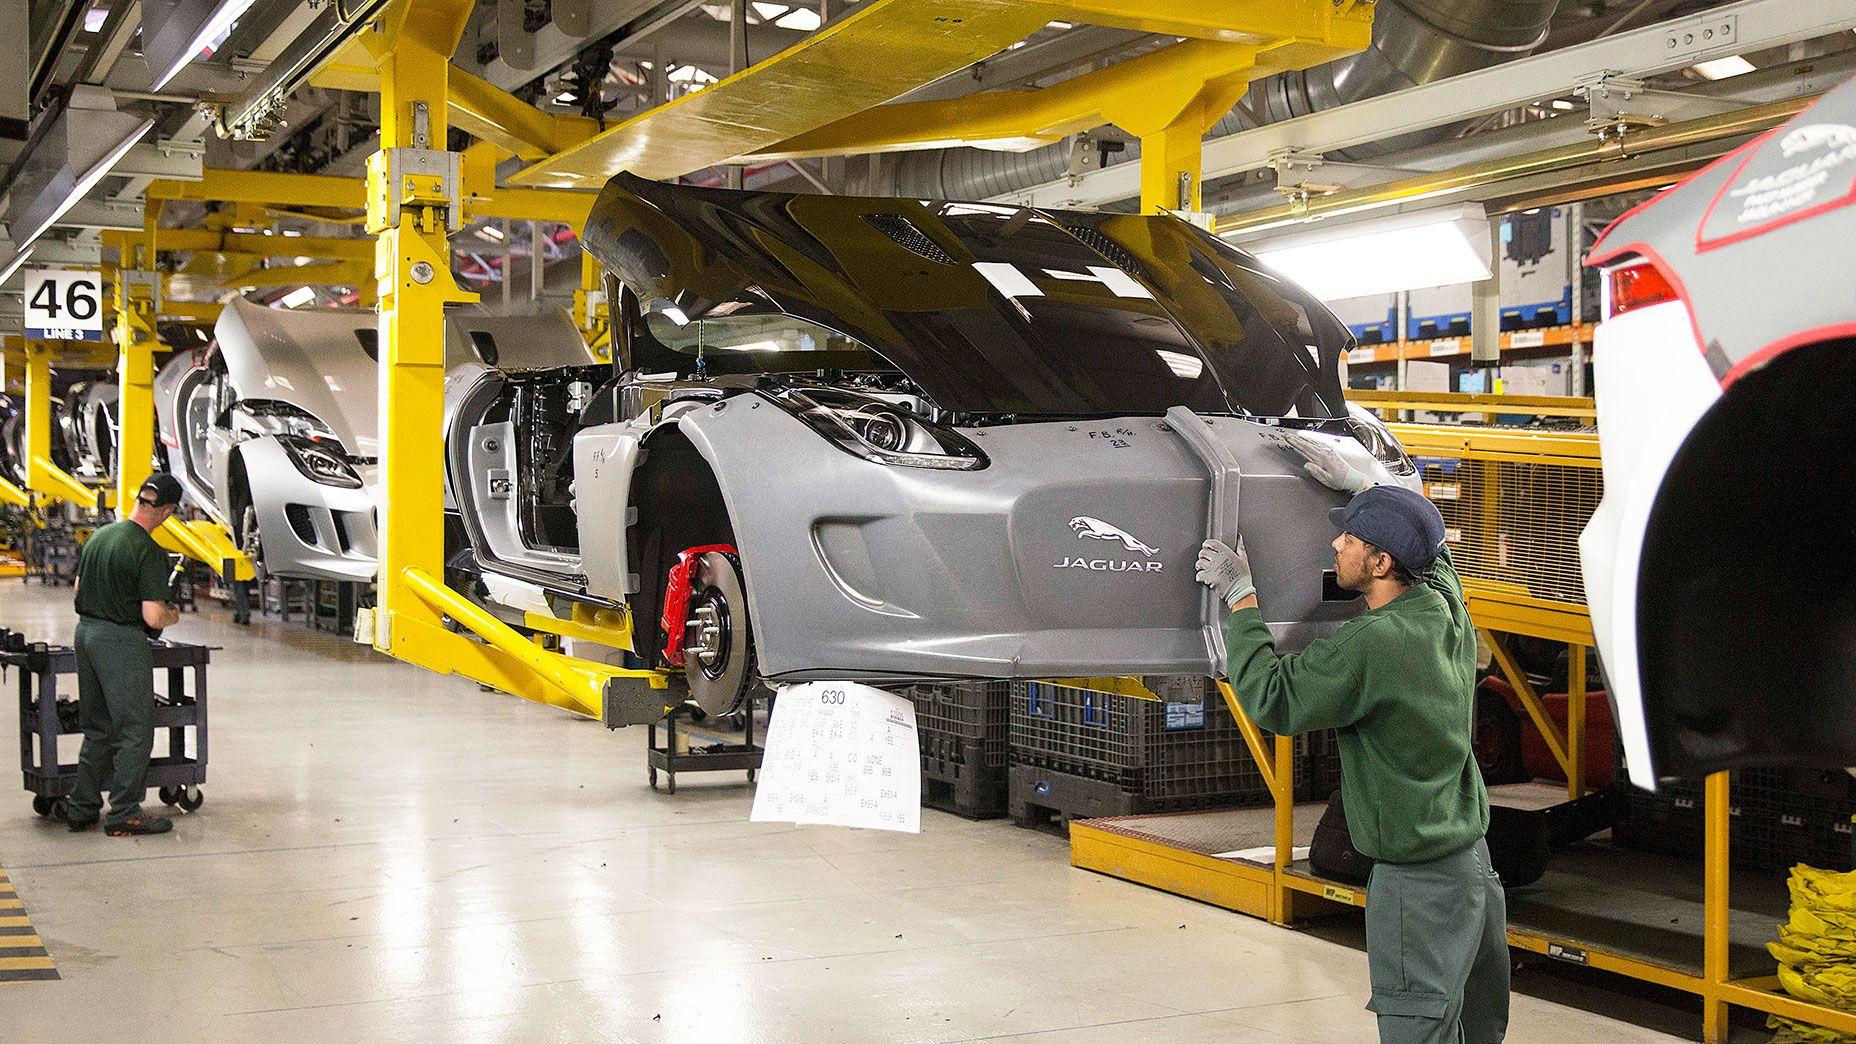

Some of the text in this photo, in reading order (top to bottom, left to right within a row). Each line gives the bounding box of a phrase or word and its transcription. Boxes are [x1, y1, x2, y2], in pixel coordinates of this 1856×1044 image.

[30, 280, 97, 320] 46
[44, 329, 84, 340] LINE 3
[1053, 557, 1163, 572] JAGUAR
[821, 690, 845, 705] 630
